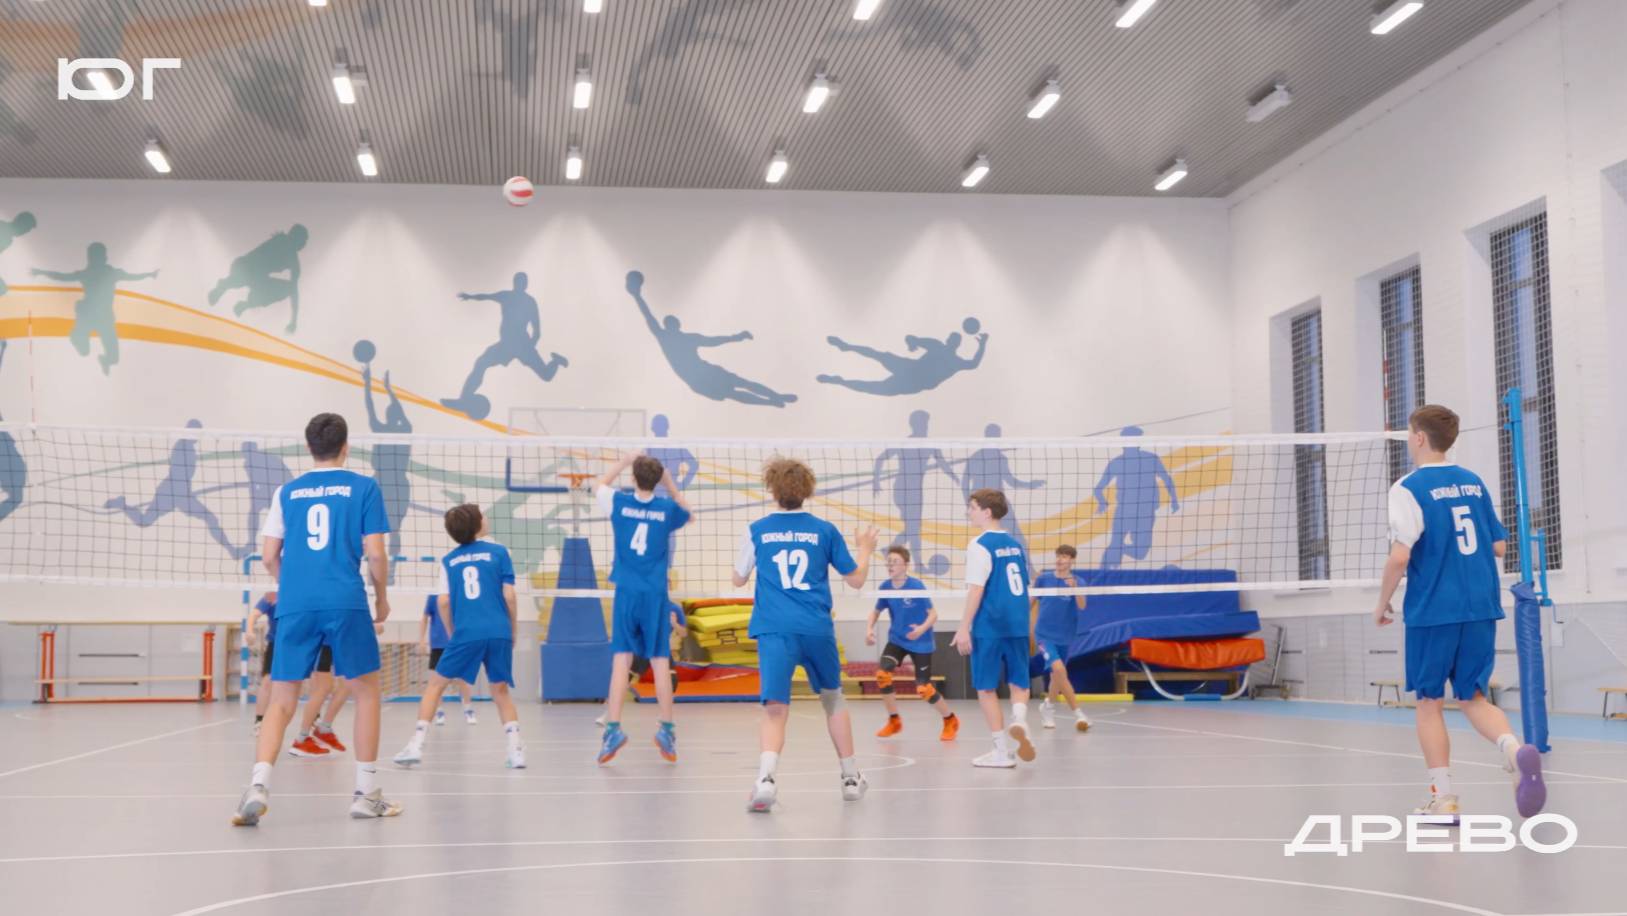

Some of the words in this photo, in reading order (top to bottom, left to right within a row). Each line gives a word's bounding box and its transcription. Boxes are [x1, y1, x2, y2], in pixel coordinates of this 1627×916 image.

[307, 503, 330, 550] 9
[630, 523, 648, 555] 4
[1452, 505, 1478, 555] 5
[463, 566, 481, 599] 8
[772, 549, 810, 590] 12
[1006, 562, 1024, 596] 6
